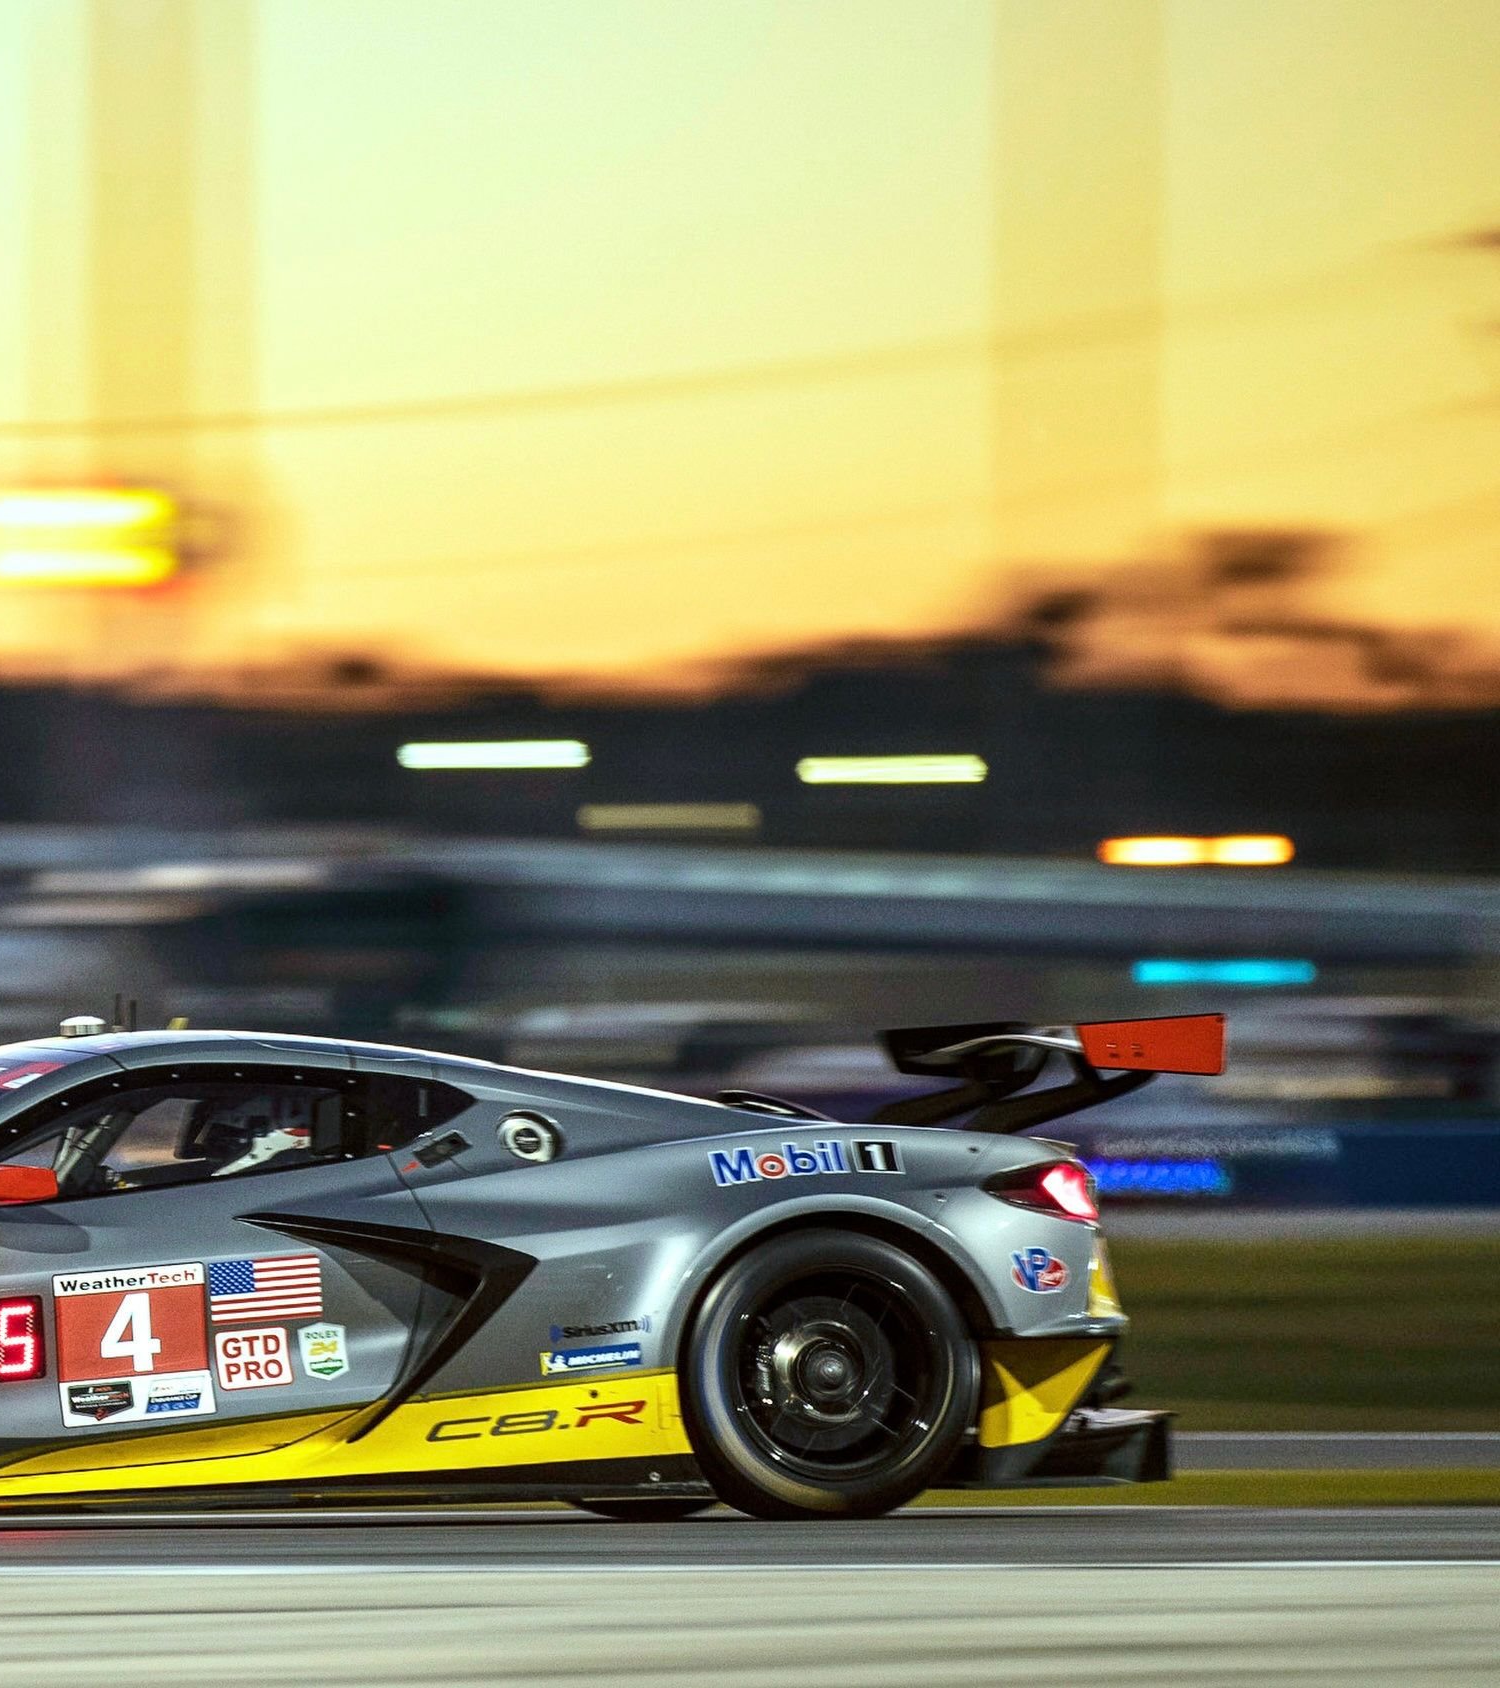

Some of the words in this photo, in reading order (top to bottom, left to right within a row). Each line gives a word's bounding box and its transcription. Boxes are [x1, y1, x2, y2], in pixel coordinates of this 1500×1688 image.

[707, 1140, 851, 1187] Mobil
[60, 1270, 195, 1292] WeatherTech
[1011, 1247, 1050, 1292] VP
[100, 1292, 162, 1373] 4
[304, 1330, 338, 1339] ROLEX
[222, 1335, 280, 1359] GTD
[567, 1349, 641, 1367] MICHELIN
[225, 1359, 283, 1383] PRO
[426, 1400, 647, 1443] C8.R
